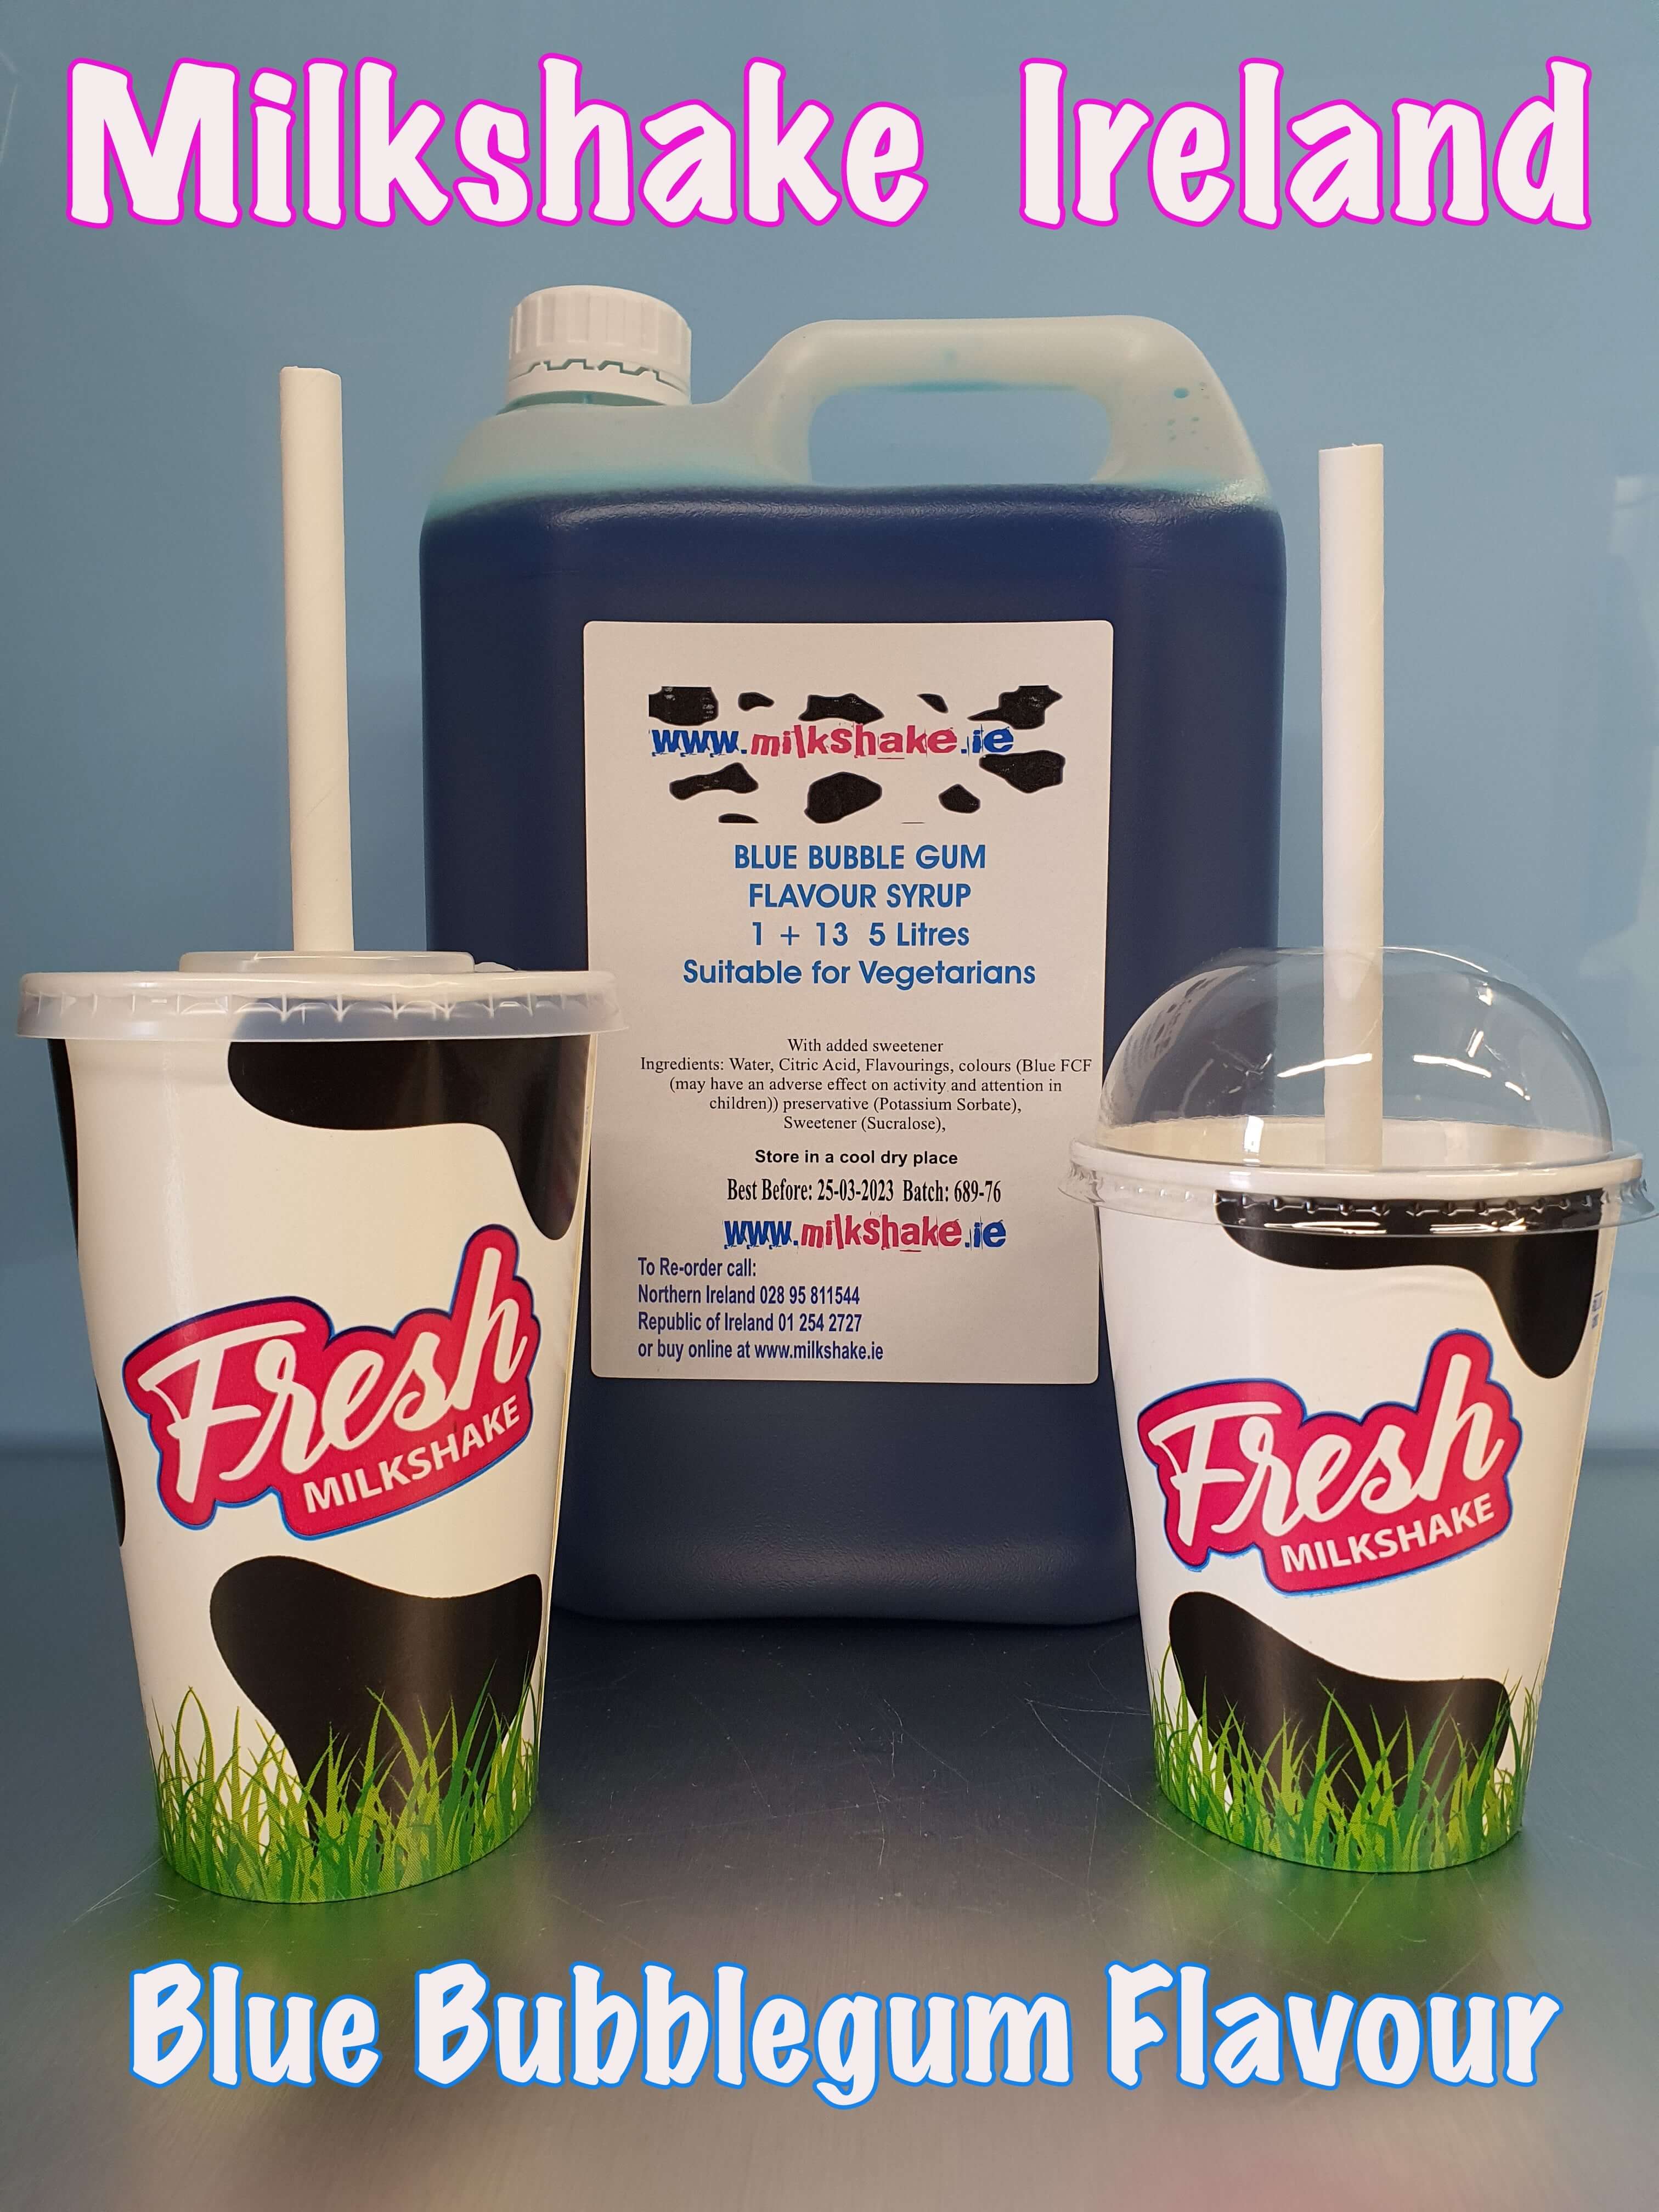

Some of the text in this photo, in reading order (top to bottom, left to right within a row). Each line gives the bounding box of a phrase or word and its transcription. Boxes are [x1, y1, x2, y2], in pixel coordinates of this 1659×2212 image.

[651, 723, 1014, 758] www.milkshake.ie
[735, 844, 986, 870] BLUE BUBBLE GUM
[749, 883, 972, 909] FLAVOUR SYRUP
[752, 921, 970, 947] 1 + 13 5 Litres
[683, 959, 1036, 991] Suitable for Vegetarians
[787, 1038, 944, 1052] With added sweetener
[640, 1057, 1092, 1075] Ingredients: Water, Citric Acid, Flavourings, colours (Blue FCF
[669, 1076, 1062, 1095] (may have an adverse effect on activity and attention in
[709, 1096, 1022, 1115] children)) preservative (Potassium Sorbate),
[784, 1115, 946, 1134] Sweetener (Sucralose),
[754, 1149, 958, 1167] Store in a cool dry place
[727, 1177, 1001, 1203] Best Before: 25-03-2023 Batch: 689-76
[724, 1213, 1007, 1252] www.milkshake.ie
[637, 1257, 756, 1277] To Re-order call:
[638, 1284, 860, 1305] Northern Ireland 028 95 811544
[638, 1311, 862, 1335] Republic of Ireland 01 254 2727
[638, 1338, 884, 1362] or buy online at www.milkshake.ie
[138, 1247, 528, 1503] Fresh
[303, 1395, 520, 1513] MILKSHAKE
[1148, 1353, 1504, 1547] Fresh
[1280, 1493, 1495, 1573] MILKSHAKE
